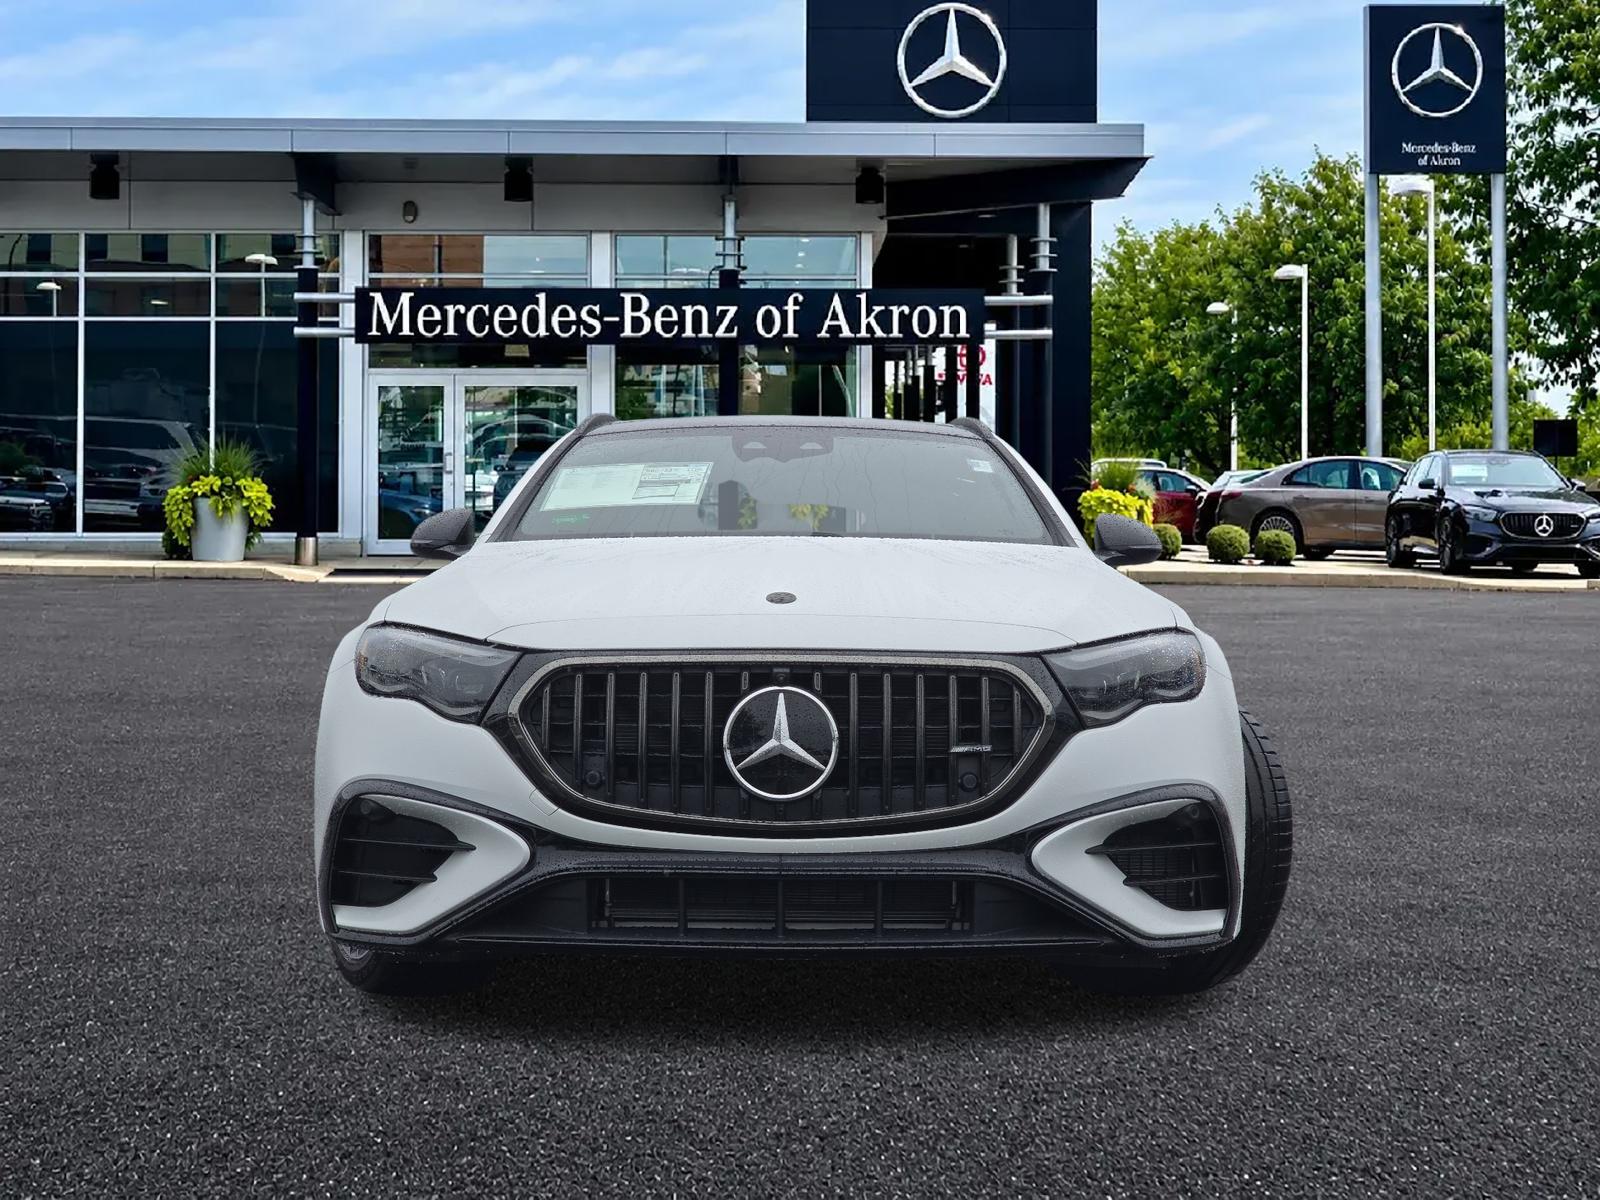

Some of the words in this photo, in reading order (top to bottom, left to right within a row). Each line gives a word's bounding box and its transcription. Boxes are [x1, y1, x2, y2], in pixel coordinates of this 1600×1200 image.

[1401, 142, 1476, 154] Mercedes-Benz
[1417, 154, 1428, 166] of
[1430, 154, 1461, 166] Akron
[367, 291, 738, 338] Mercedes-Benz
[756, 292, 804, 338] of
[817, 292, 970, 338] Akron
